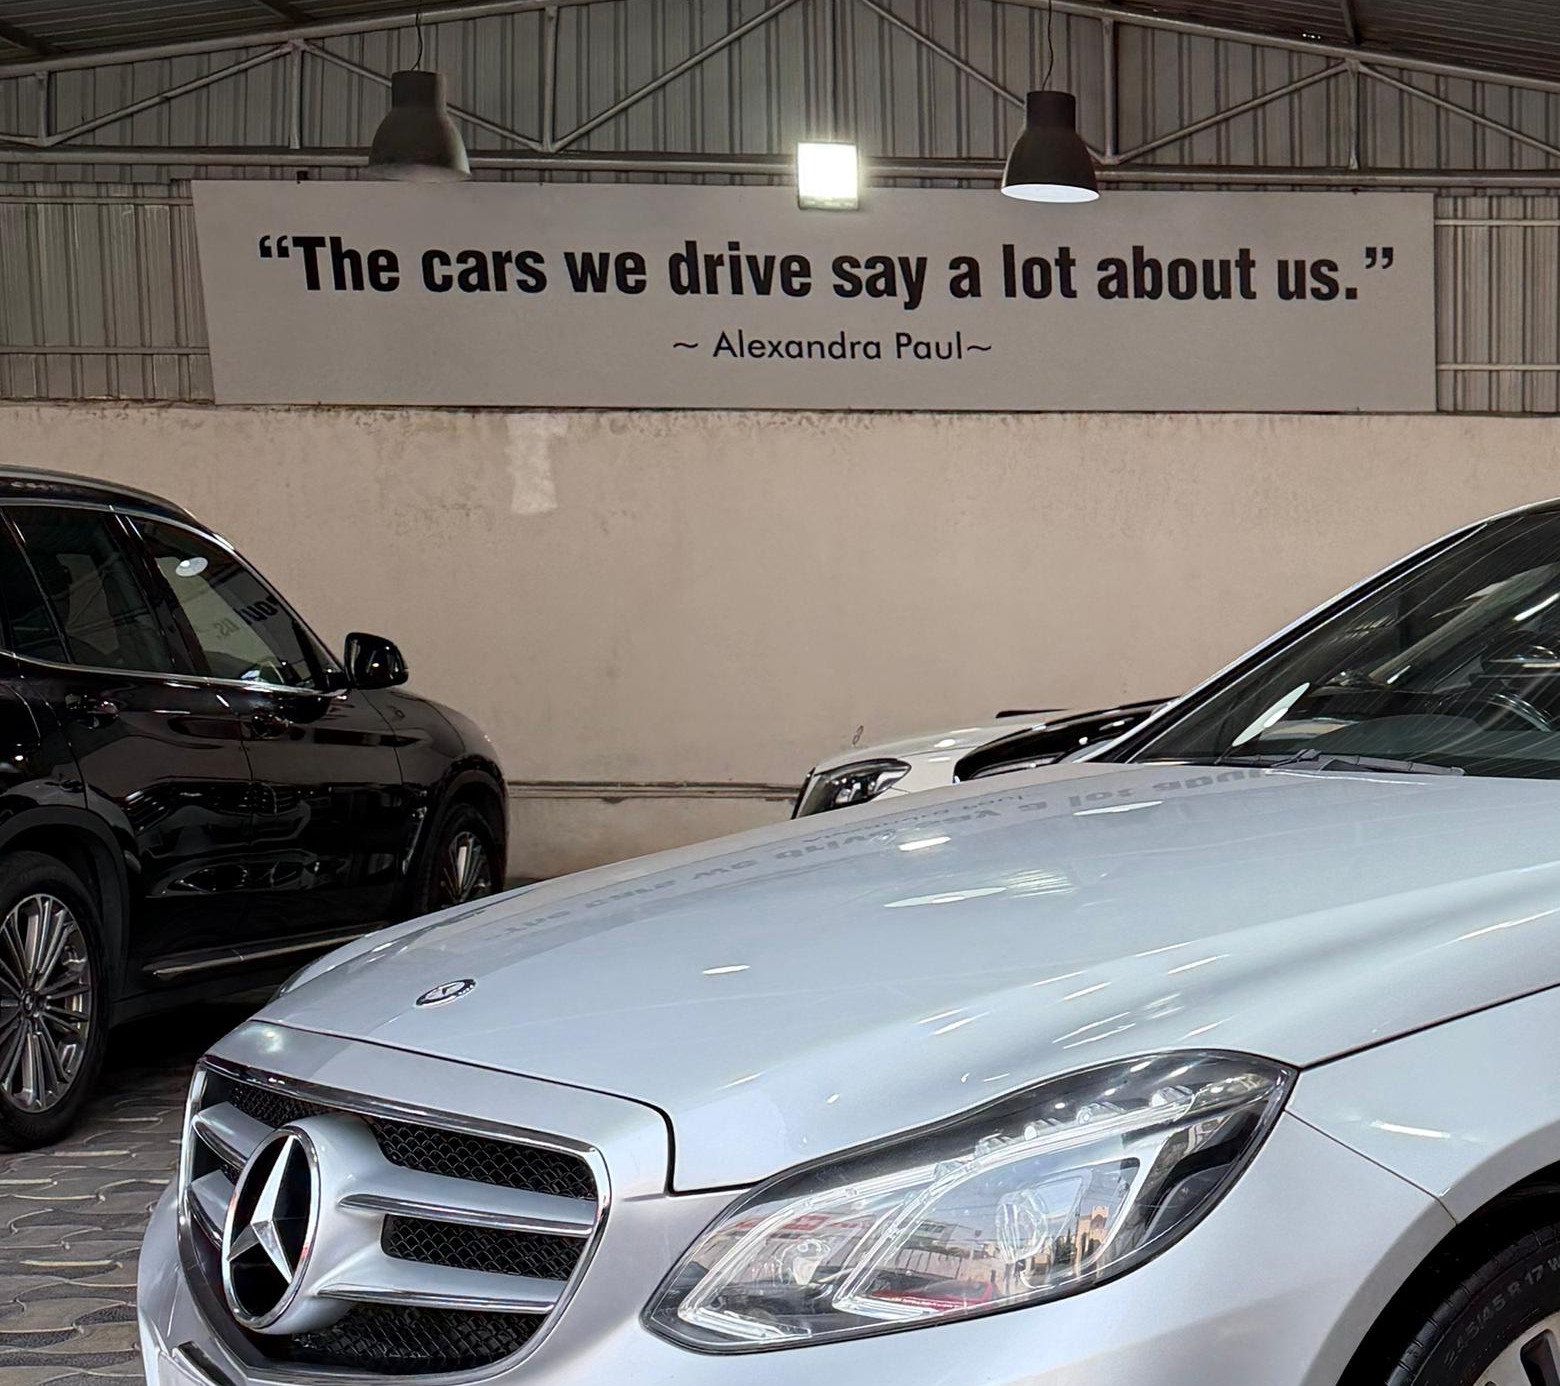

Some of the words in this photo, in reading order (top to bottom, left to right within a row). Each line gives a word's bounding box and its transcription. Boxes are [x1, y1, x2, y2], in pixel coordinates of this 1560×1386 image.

[258, 234, 400, 293] “The
[421, 249, 548, 294] cars
[563, 251, 647, 295] we
[668, 240, 812, 298] drive
[831, 255, 928, 311] say
[948, 255, 982, 299] a
[1002, 243, 1078, 300] lot
[1096, 245, 1257, 301] about
[1277, 246, 1394, 301] us.”
[712, 329, 881, 360] Alexandra
